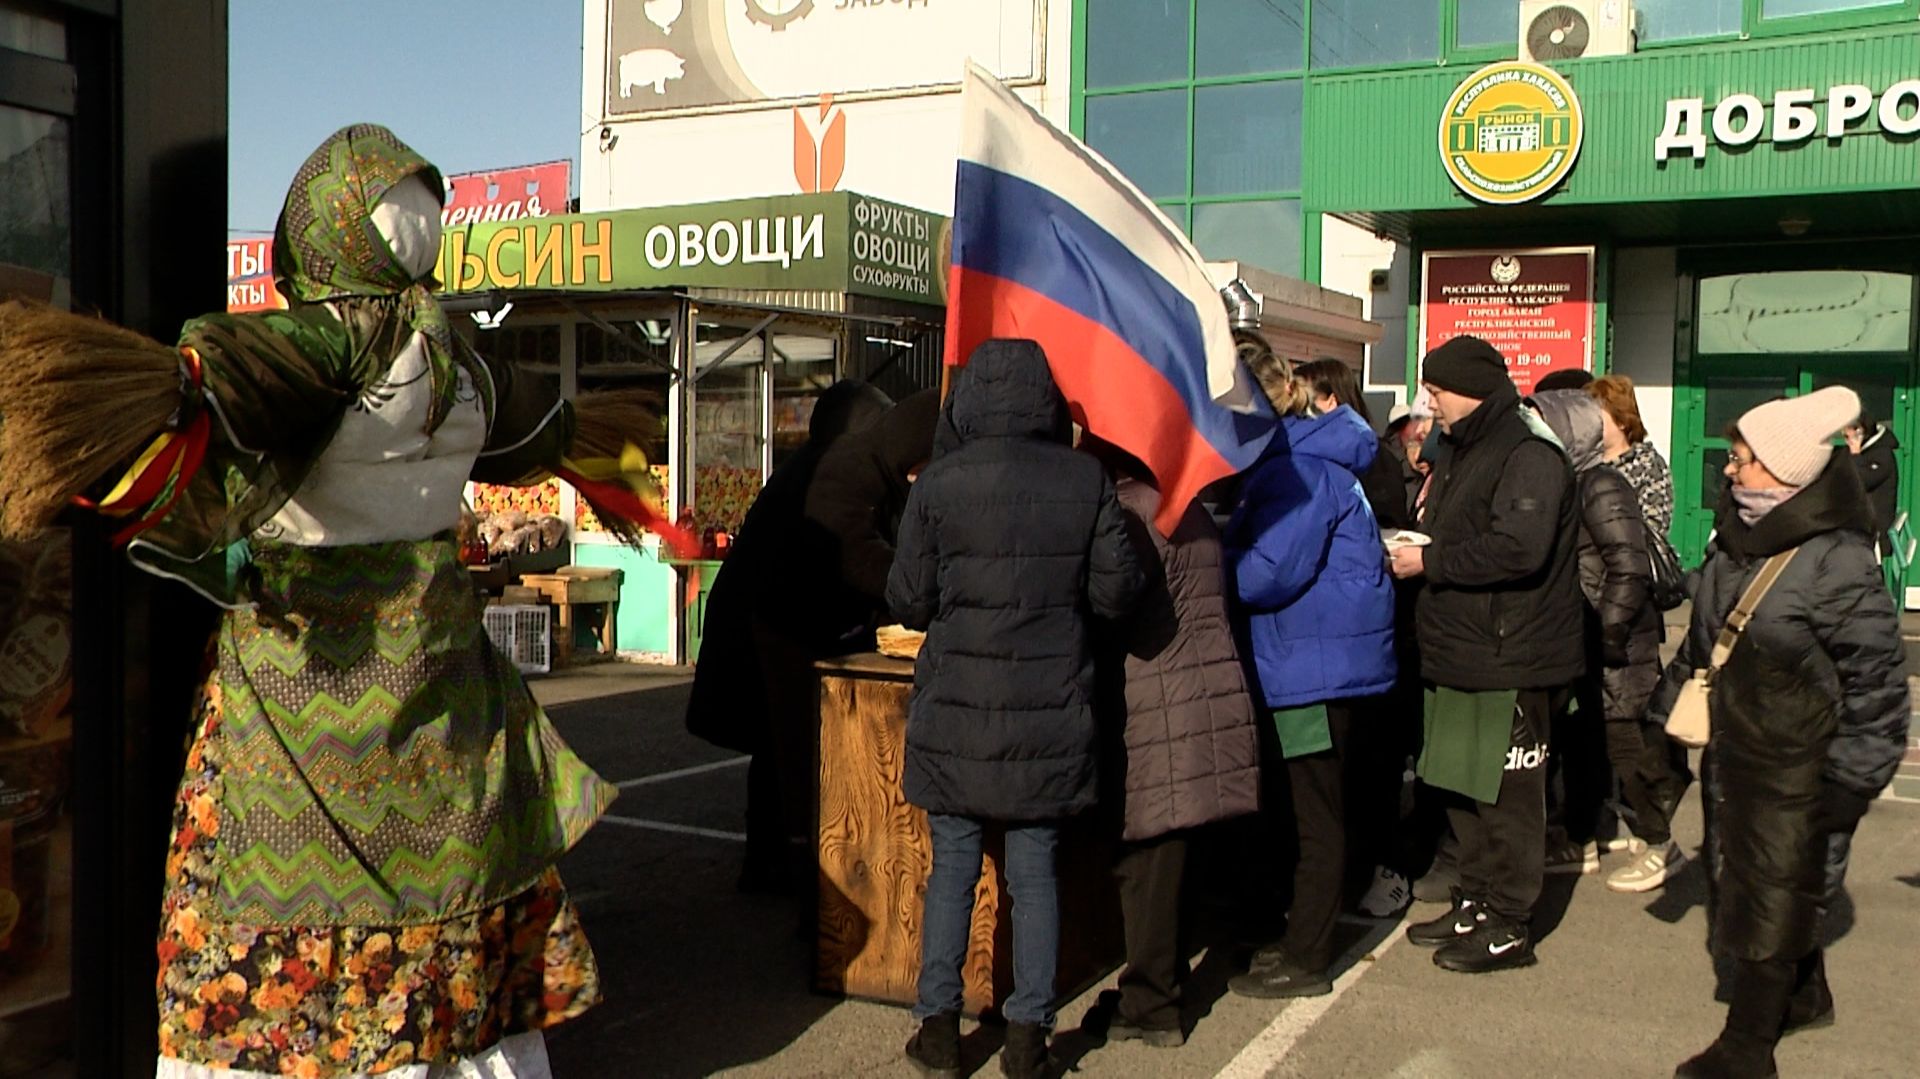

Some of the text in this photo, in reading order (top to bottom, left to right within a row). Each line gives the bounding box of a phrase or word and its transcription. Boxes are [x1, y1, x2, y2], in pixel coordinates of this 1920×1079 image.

[1522, 72, 1566, 109] ХАКАСИЯ
[1485, 113, 1534, 125] РЫНОК
[1655, 80, 1920, 160] ДОБРО
[854, 199, 929, 241] ФРУКТЫ
[644, 214, 824, 269] ОВОЩИ
[853, 230, 930, 275] ОВОЩИ
[853, 264, 929, 295] СУХОФРУКТЫ
[1442, 283, 1571, 294] РОССИЙСКАЯ ФЕДЕРАЦИЯ
[1448, 295, 1563, 305] РЕСПУБЛИКА ХАКАСИЯ
[1467, 307, 1542, 317] ГОРОД АБАКАН
[1516, 353, 1551, 366] 19-00
